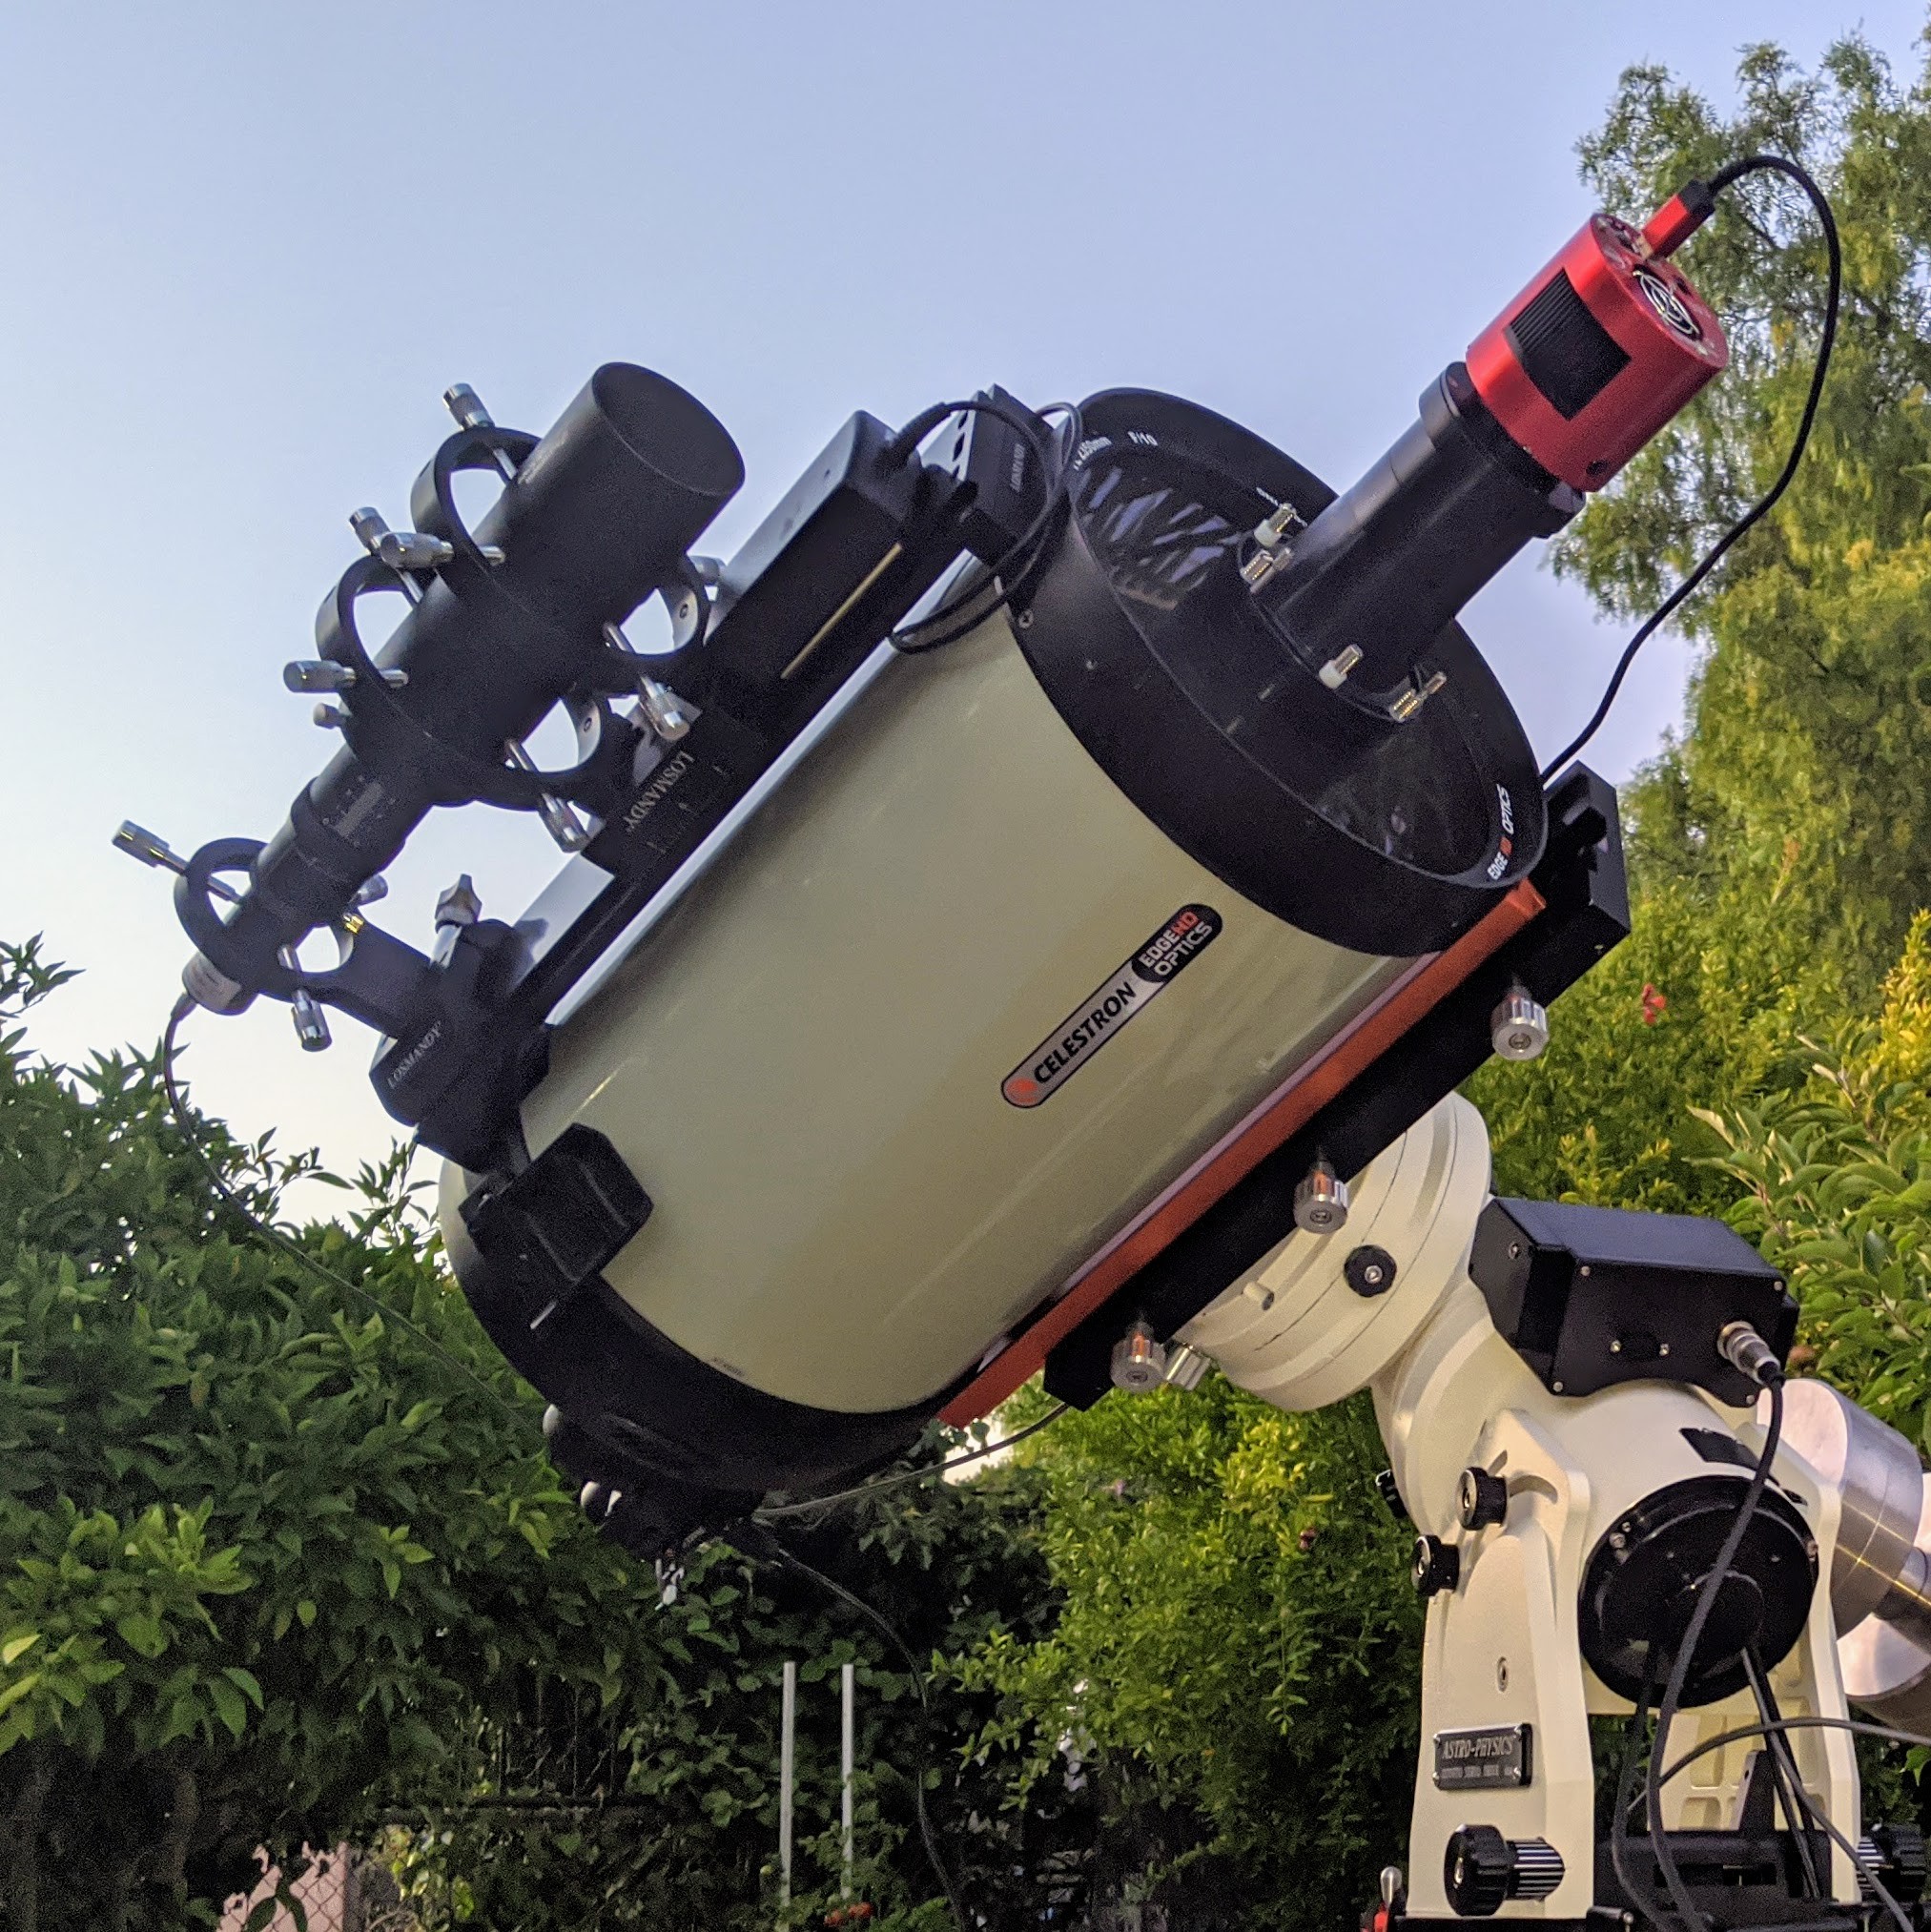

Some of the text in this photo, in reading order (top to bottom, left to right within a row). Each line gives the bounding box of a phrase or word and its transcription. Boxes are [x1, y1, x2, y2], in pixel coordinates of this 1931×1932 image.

[624, 750, 695, 830] LOSMANDY
[1496, 783, 1514, 835] OPTICS
[1154, 921, 1213, 976] OPTICS
[1034, 981, 1137, 1083] CELESTRON
[1442, 1736, 1513, 1759] ASTRO-PHYSICS
